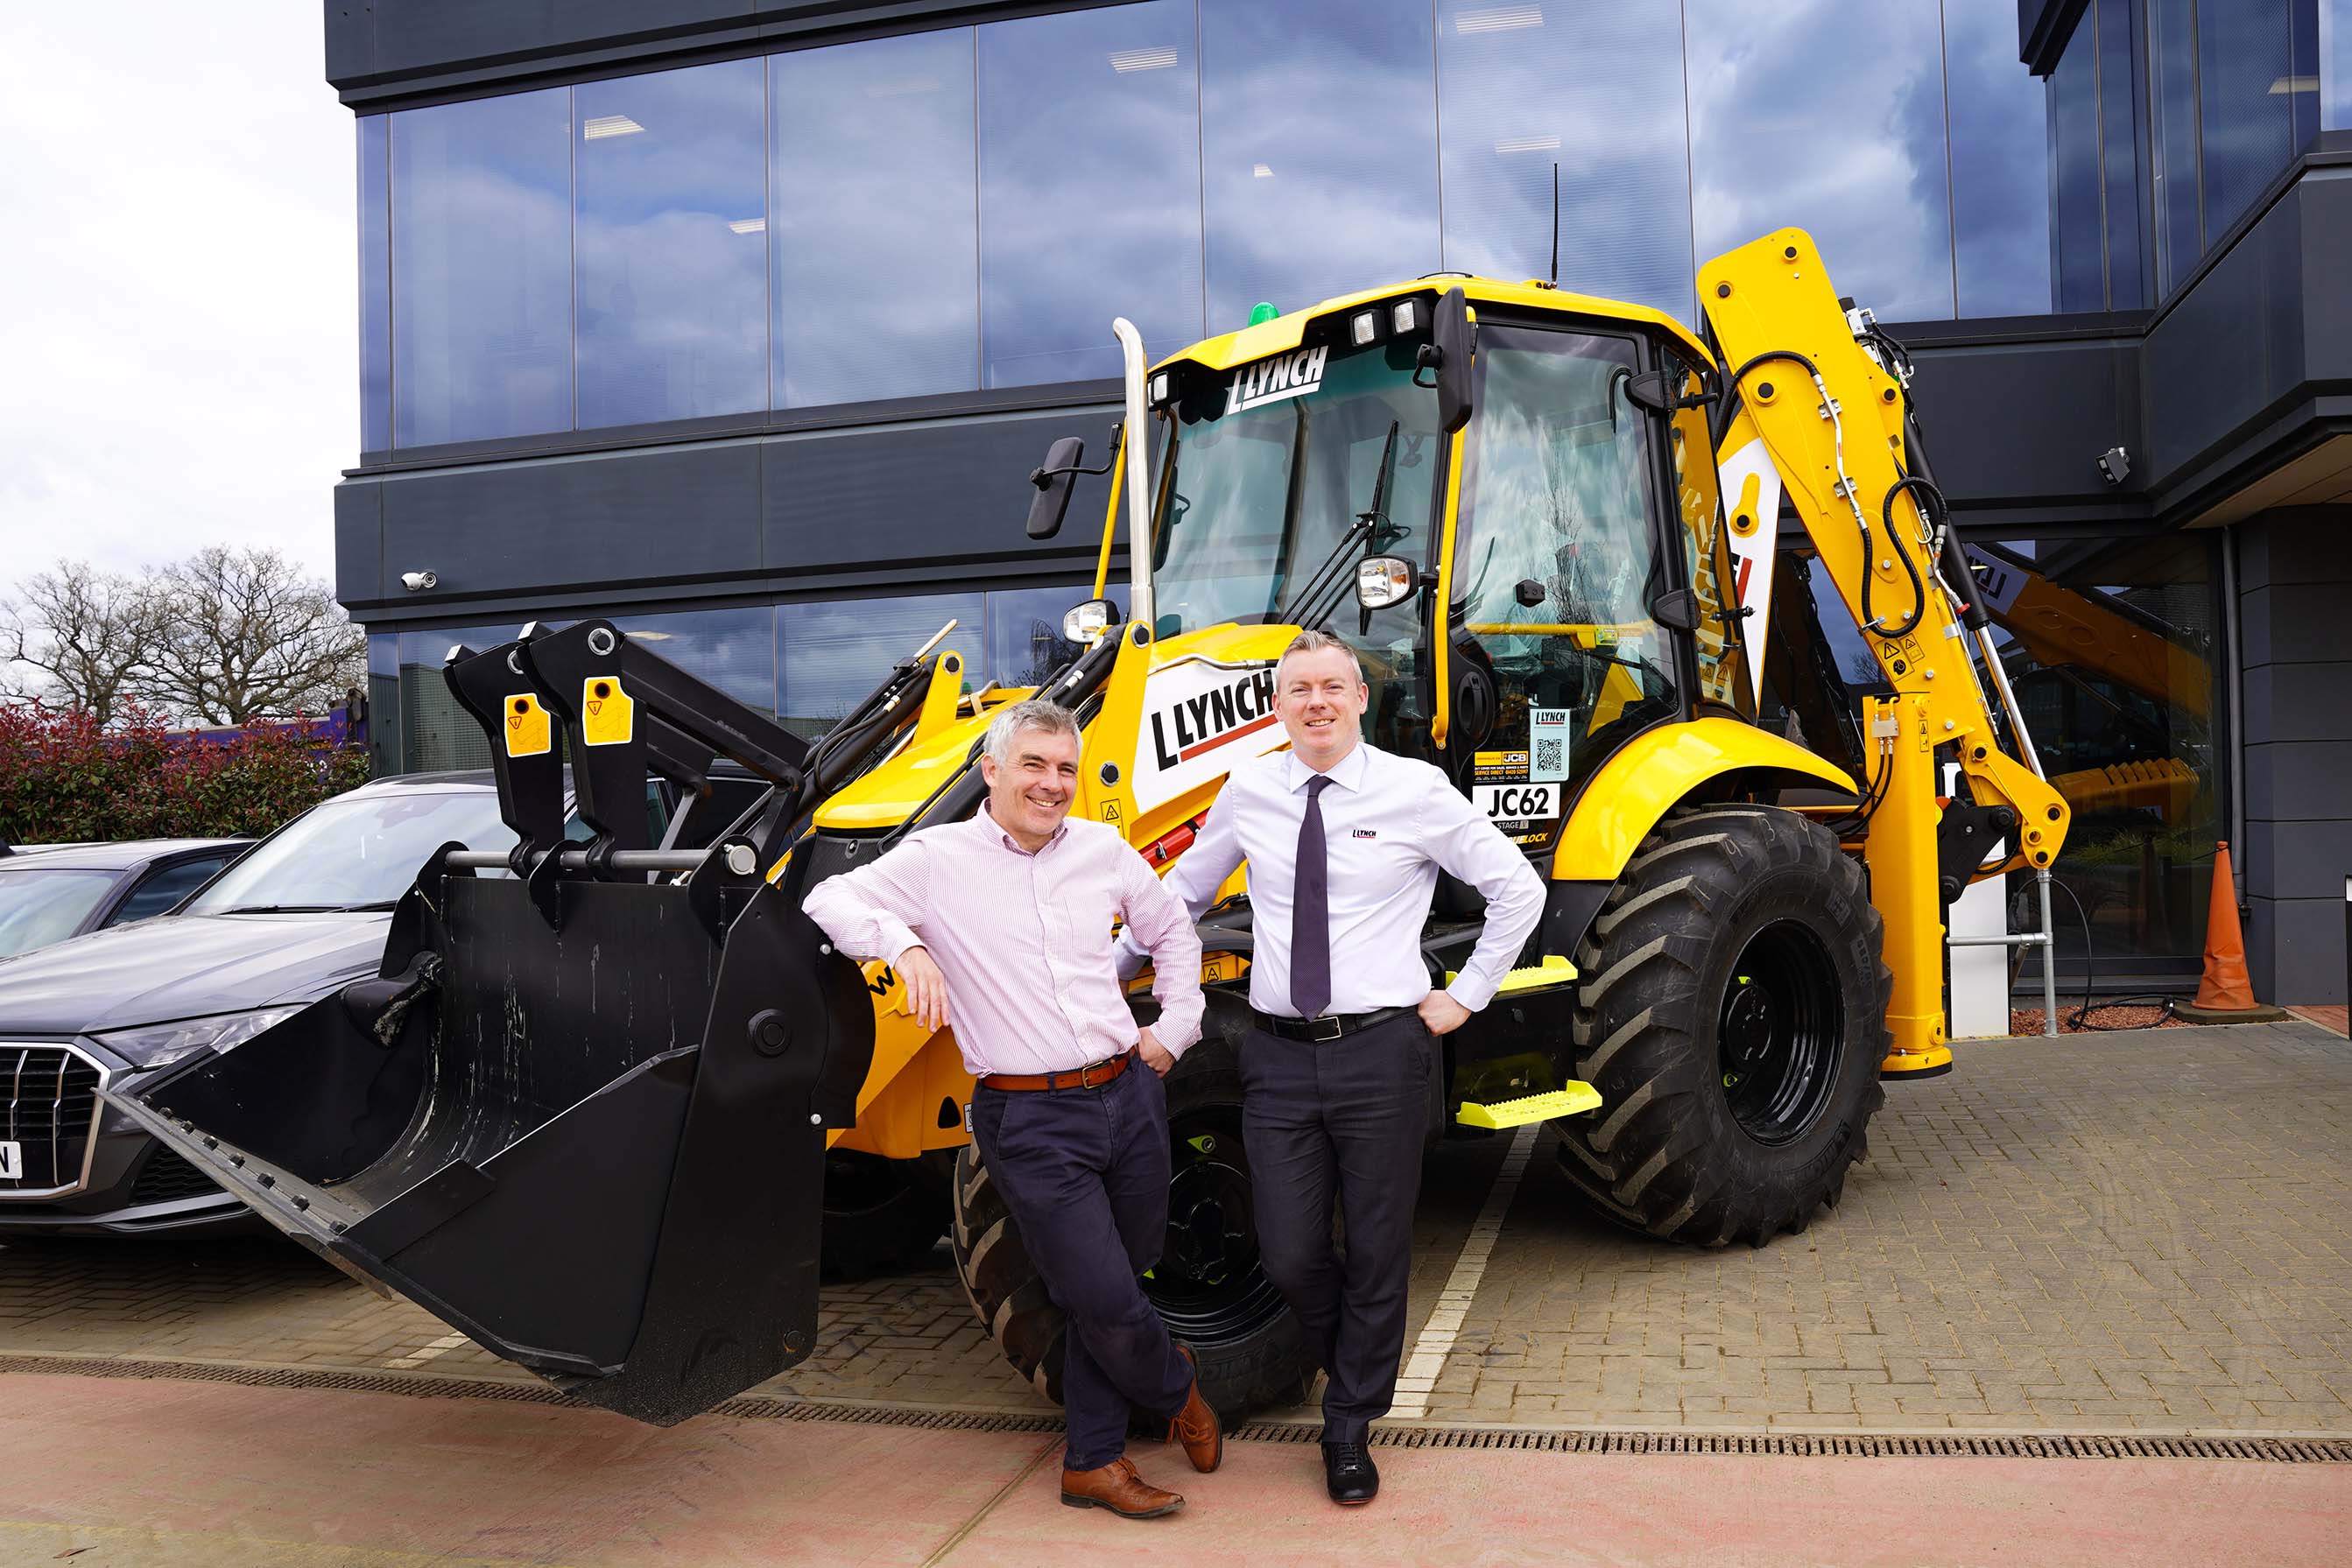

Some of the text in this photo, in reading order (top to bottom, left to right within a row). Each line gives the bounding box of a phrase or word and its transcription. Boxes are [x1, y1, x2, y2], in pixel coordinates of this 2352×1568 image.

[1503, 753, 1526, 763] JCB
[1487, 787, 1549, 818] JC62
[1497, 821, 1519, 830] STAGE
